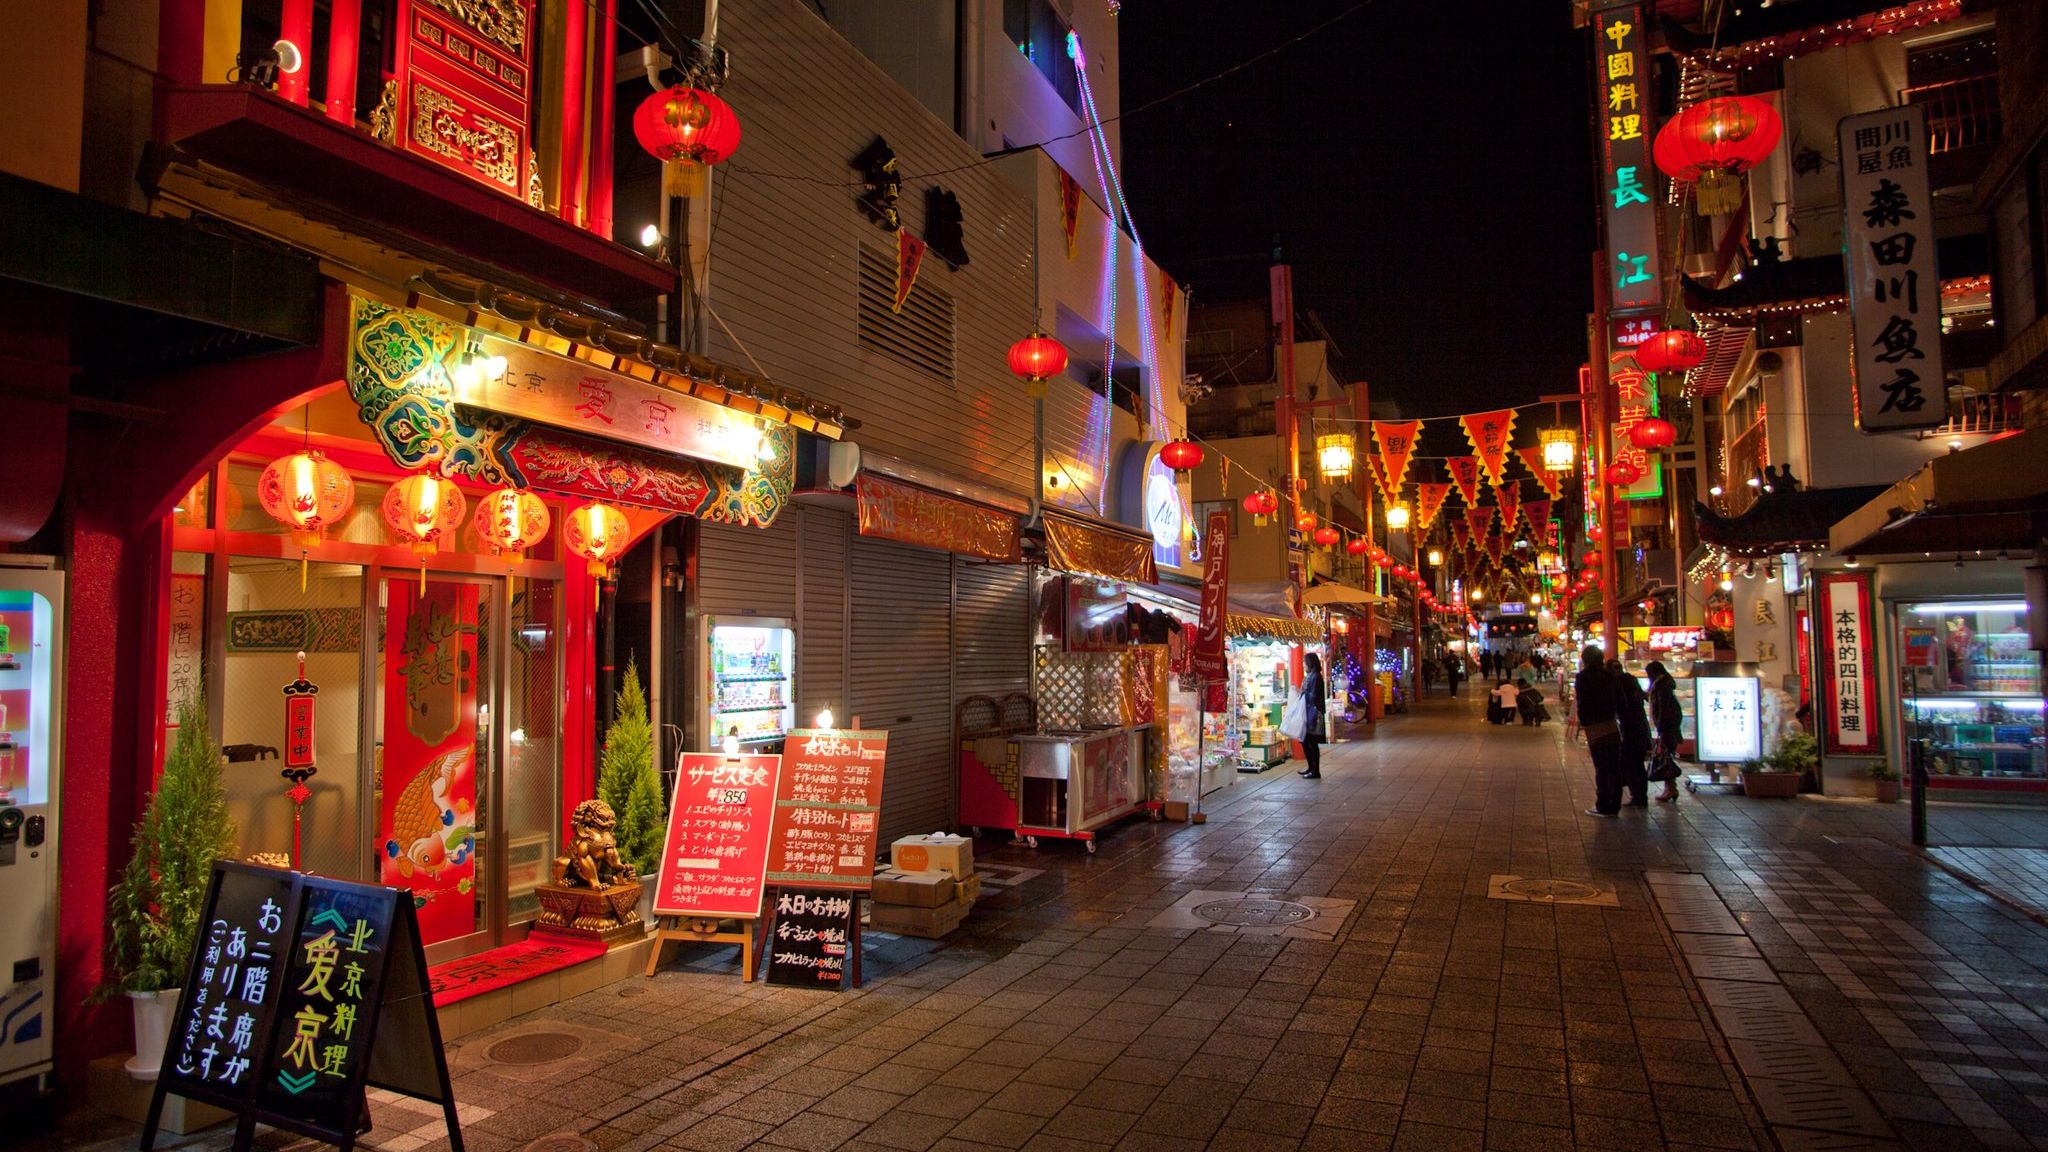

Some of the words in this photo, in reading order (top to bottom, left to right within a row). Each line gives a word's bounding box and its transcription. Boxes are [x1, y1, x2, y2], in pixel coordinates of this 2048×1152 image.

[1606, 21, 1642, 140] 中國料理
[1885, 120, 1912, 169] 川魚
[1609, 166, 1654, 289] 長江
[1862, 178, 1926, 415] 森田川魚店
[575, 376, 677, 437] 愛京
[1205, 528, 1225, 641] 神戸プリン
[1755, 599, 1777, 663] 長江
[1709, 698, 1746, 712] 長江
[1835, 610, 1860, 732] 本格的四川料理
[688, 764, 769, 787] サービス定食
[790, 808, 849, 828] 特別セット
[201, 926, 248, 1082] あります
[219, 897, 282, 1084] お二階席が
[319, 919, 374, 1078] 北京料理
